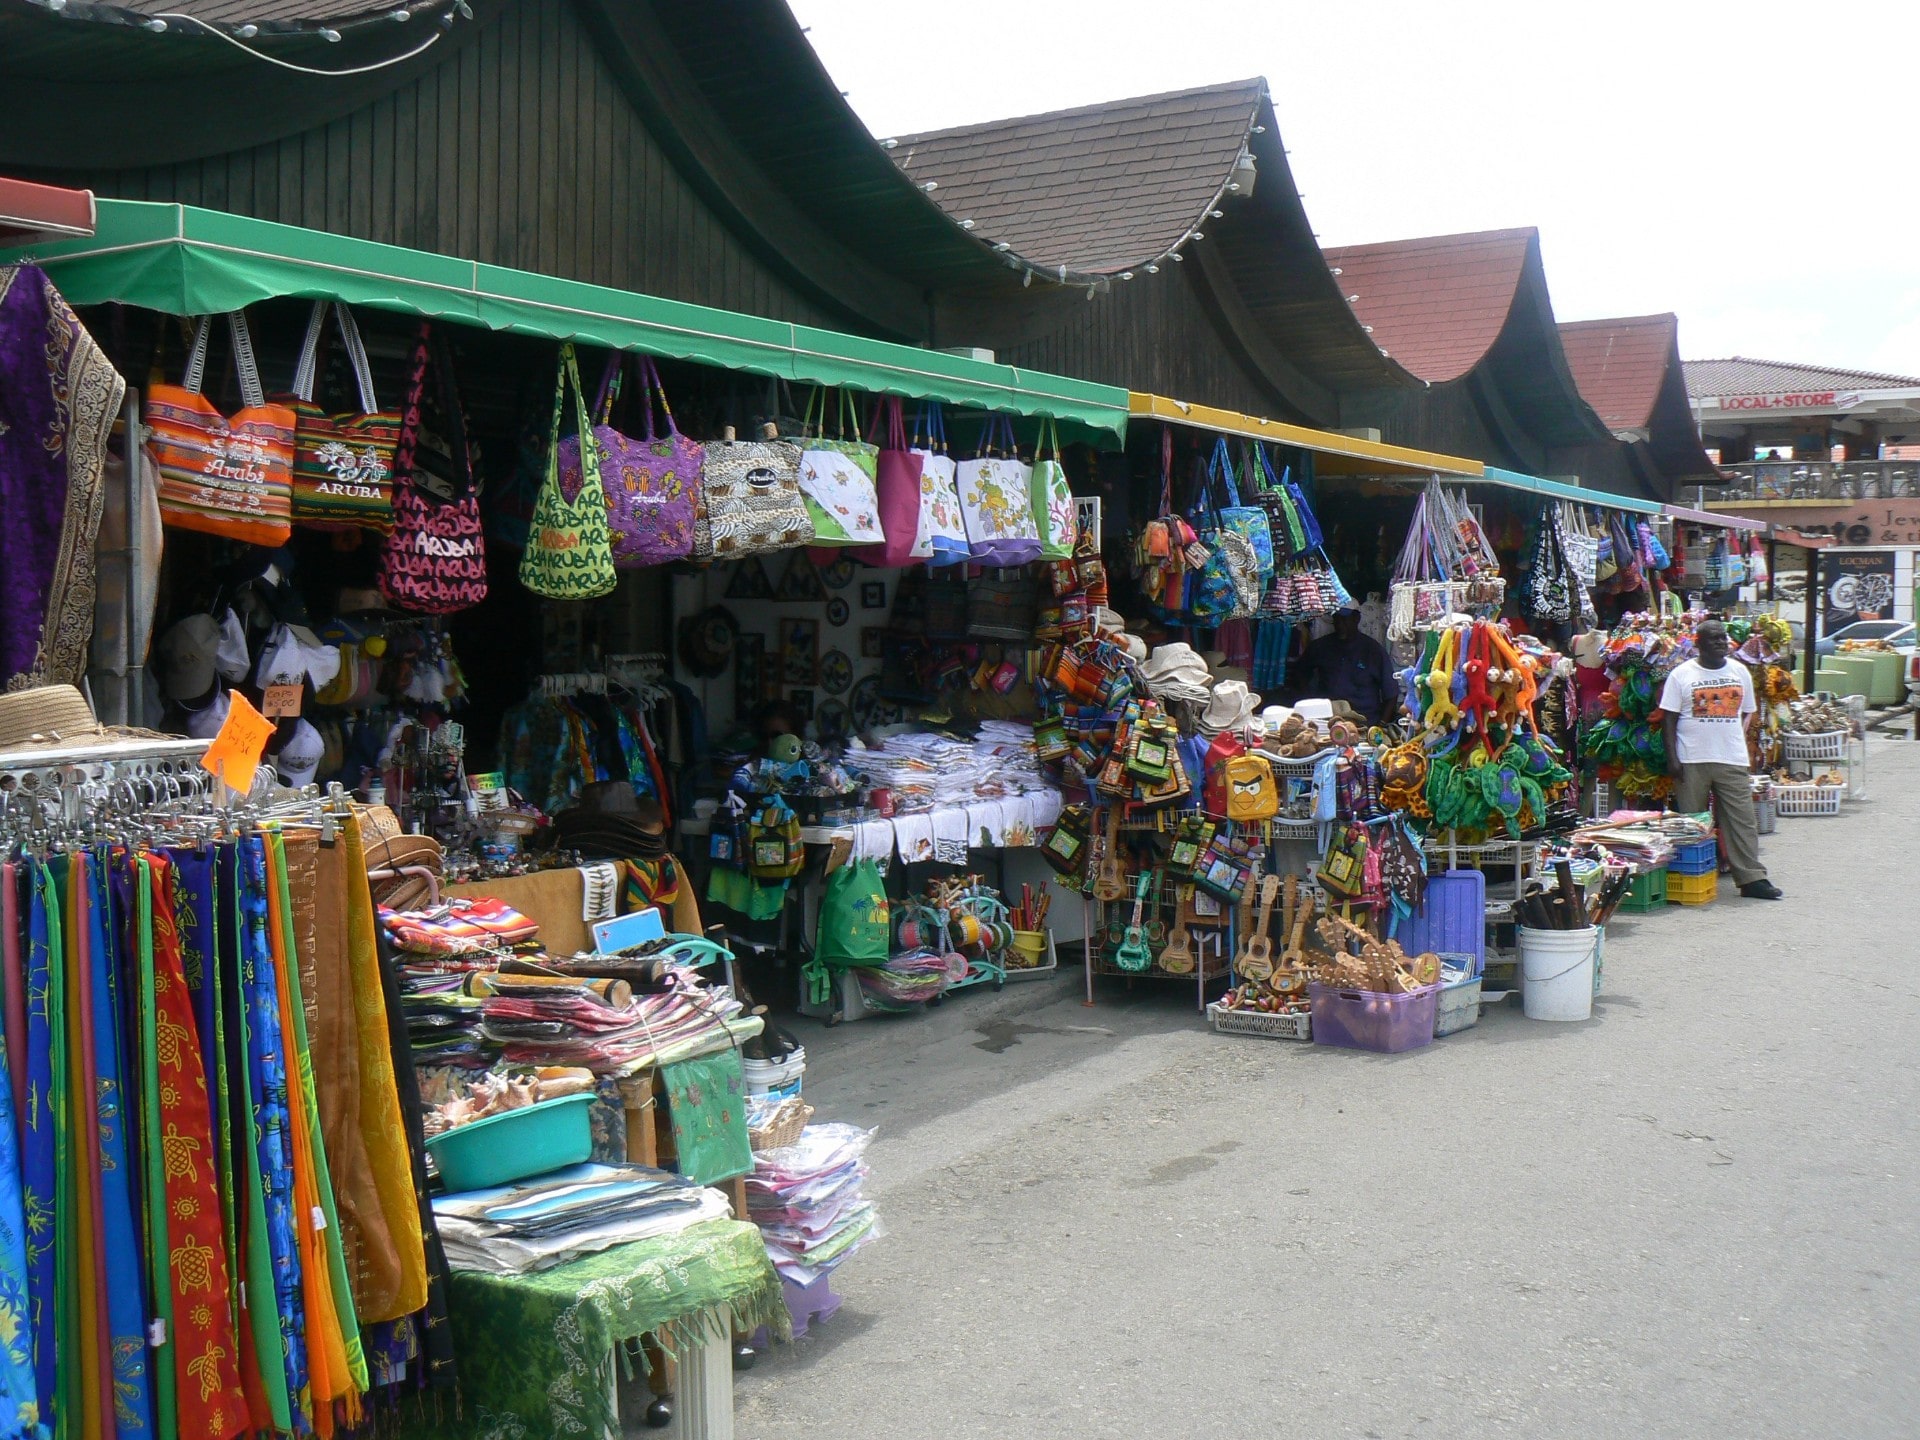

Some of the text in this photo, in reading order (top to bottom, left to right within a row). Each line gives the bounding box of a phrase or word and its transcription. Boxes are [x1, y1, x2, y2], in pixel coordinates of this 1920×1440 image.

[204, 459, 266, 484] Aruba
[315, 482, 383, 499] ARUBA
[415, 531, 474, 557] ARUBA
[1839, 557, 1882, 565] LOCMAN
